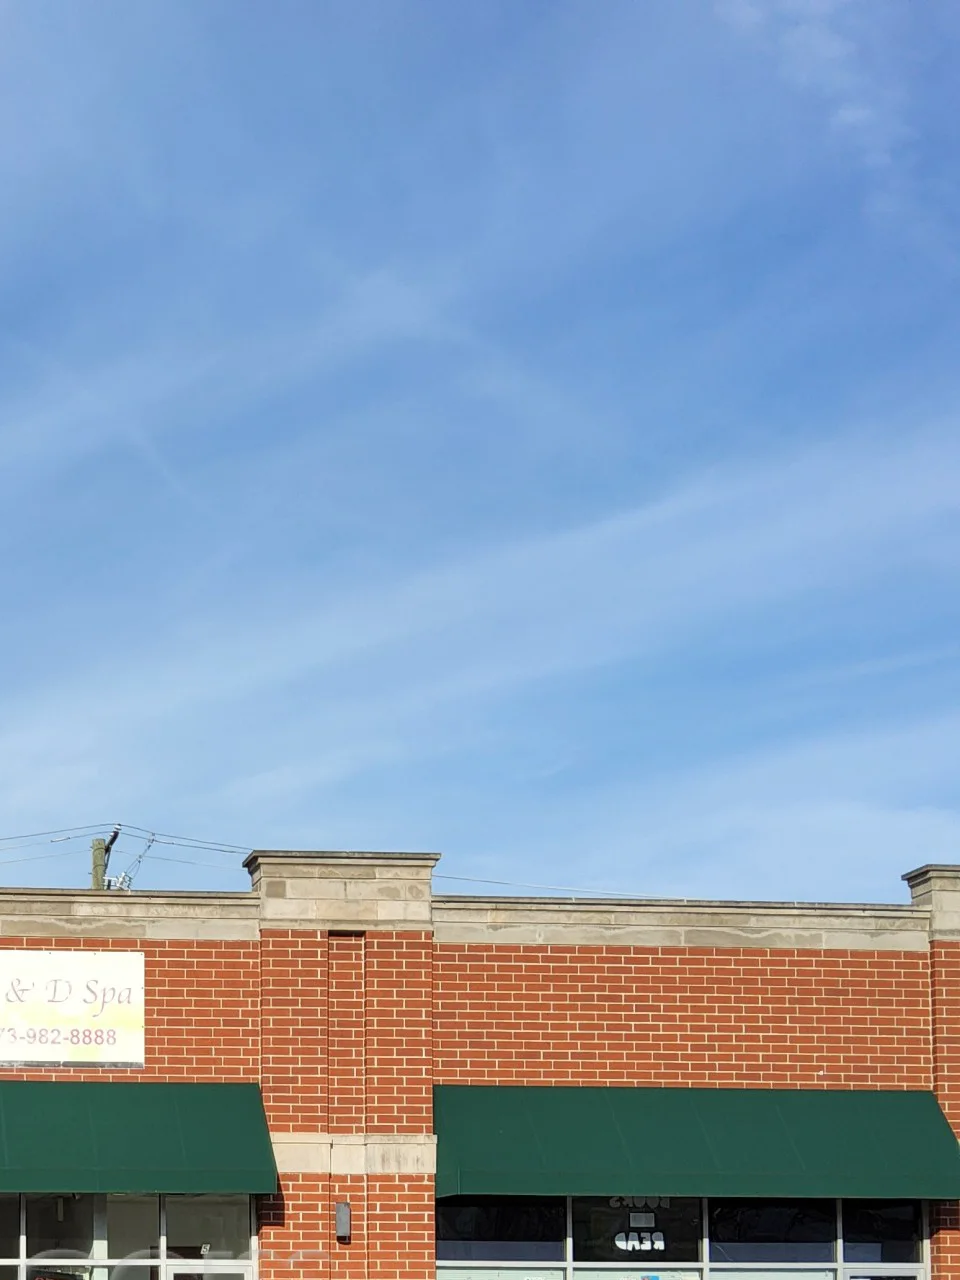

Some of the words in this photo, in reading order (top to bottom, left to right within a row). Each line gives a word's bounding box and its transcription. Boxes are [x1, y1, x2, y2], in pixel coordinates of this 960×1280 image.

[4, 977, 35, 1003] &
[45, 979, 73, 1003] D
[82, 979, 133, 1018] Spa
